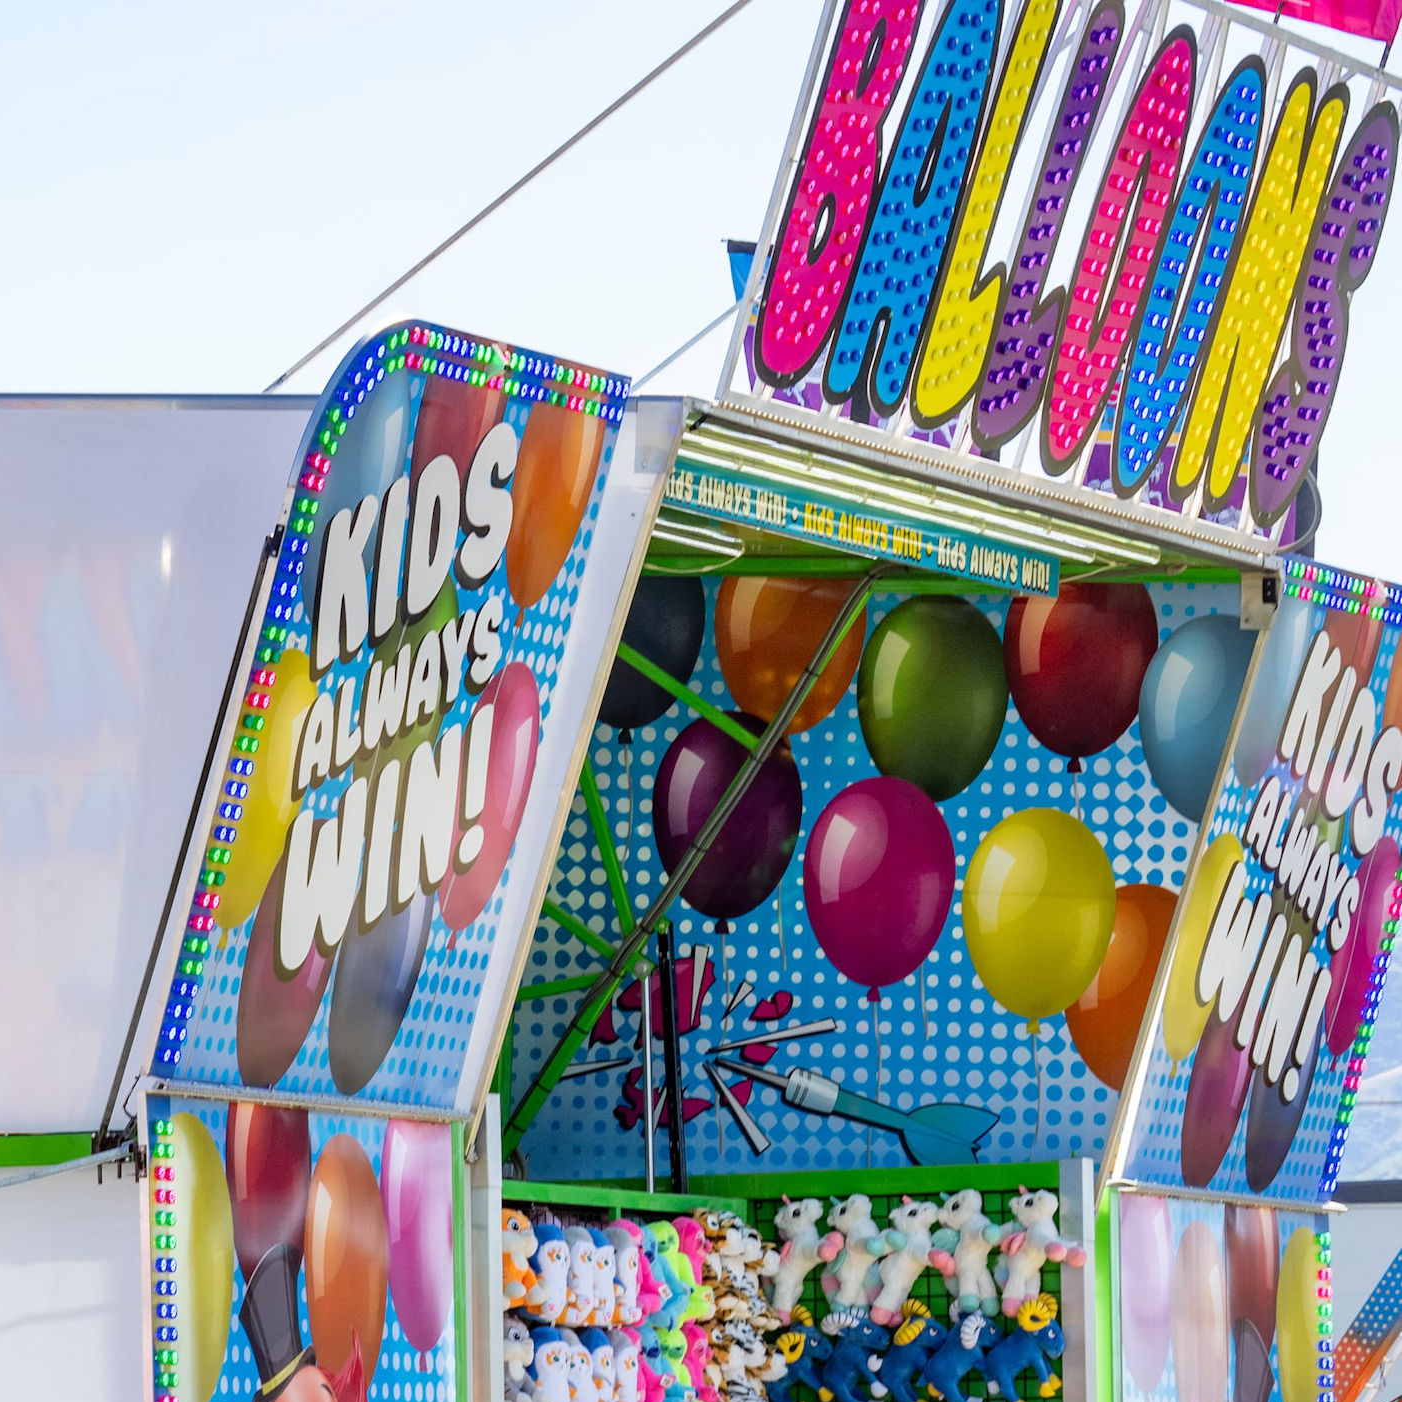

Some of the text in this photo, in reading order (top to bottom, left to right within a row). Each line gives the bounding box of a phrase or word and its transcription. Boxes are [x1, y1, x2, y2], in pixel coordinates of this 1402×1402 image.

[753, 0, 1401, 530] BALLOONS
[310, 422, 517, 681] KIDS
[755, 488, 788, 527] Win!
[803, 501, 835, 539] Kids
[837, 510, 889, 553] Always
[892, 524, 923, 561] Win!
[937, 536, 967, 571] Kids
[969, 544, 1019, 585] Always
[1021, 556, 1051, 592] Win!
[291, 596, 503, 802] ALWAYS
[1277, 629, 1402, 858] KIDS
[272, 703, 496, 982] WIN!
[1244, 775, 1361, 954] ALWAYS
[1194, 861, 1332, 1103] WIN!
